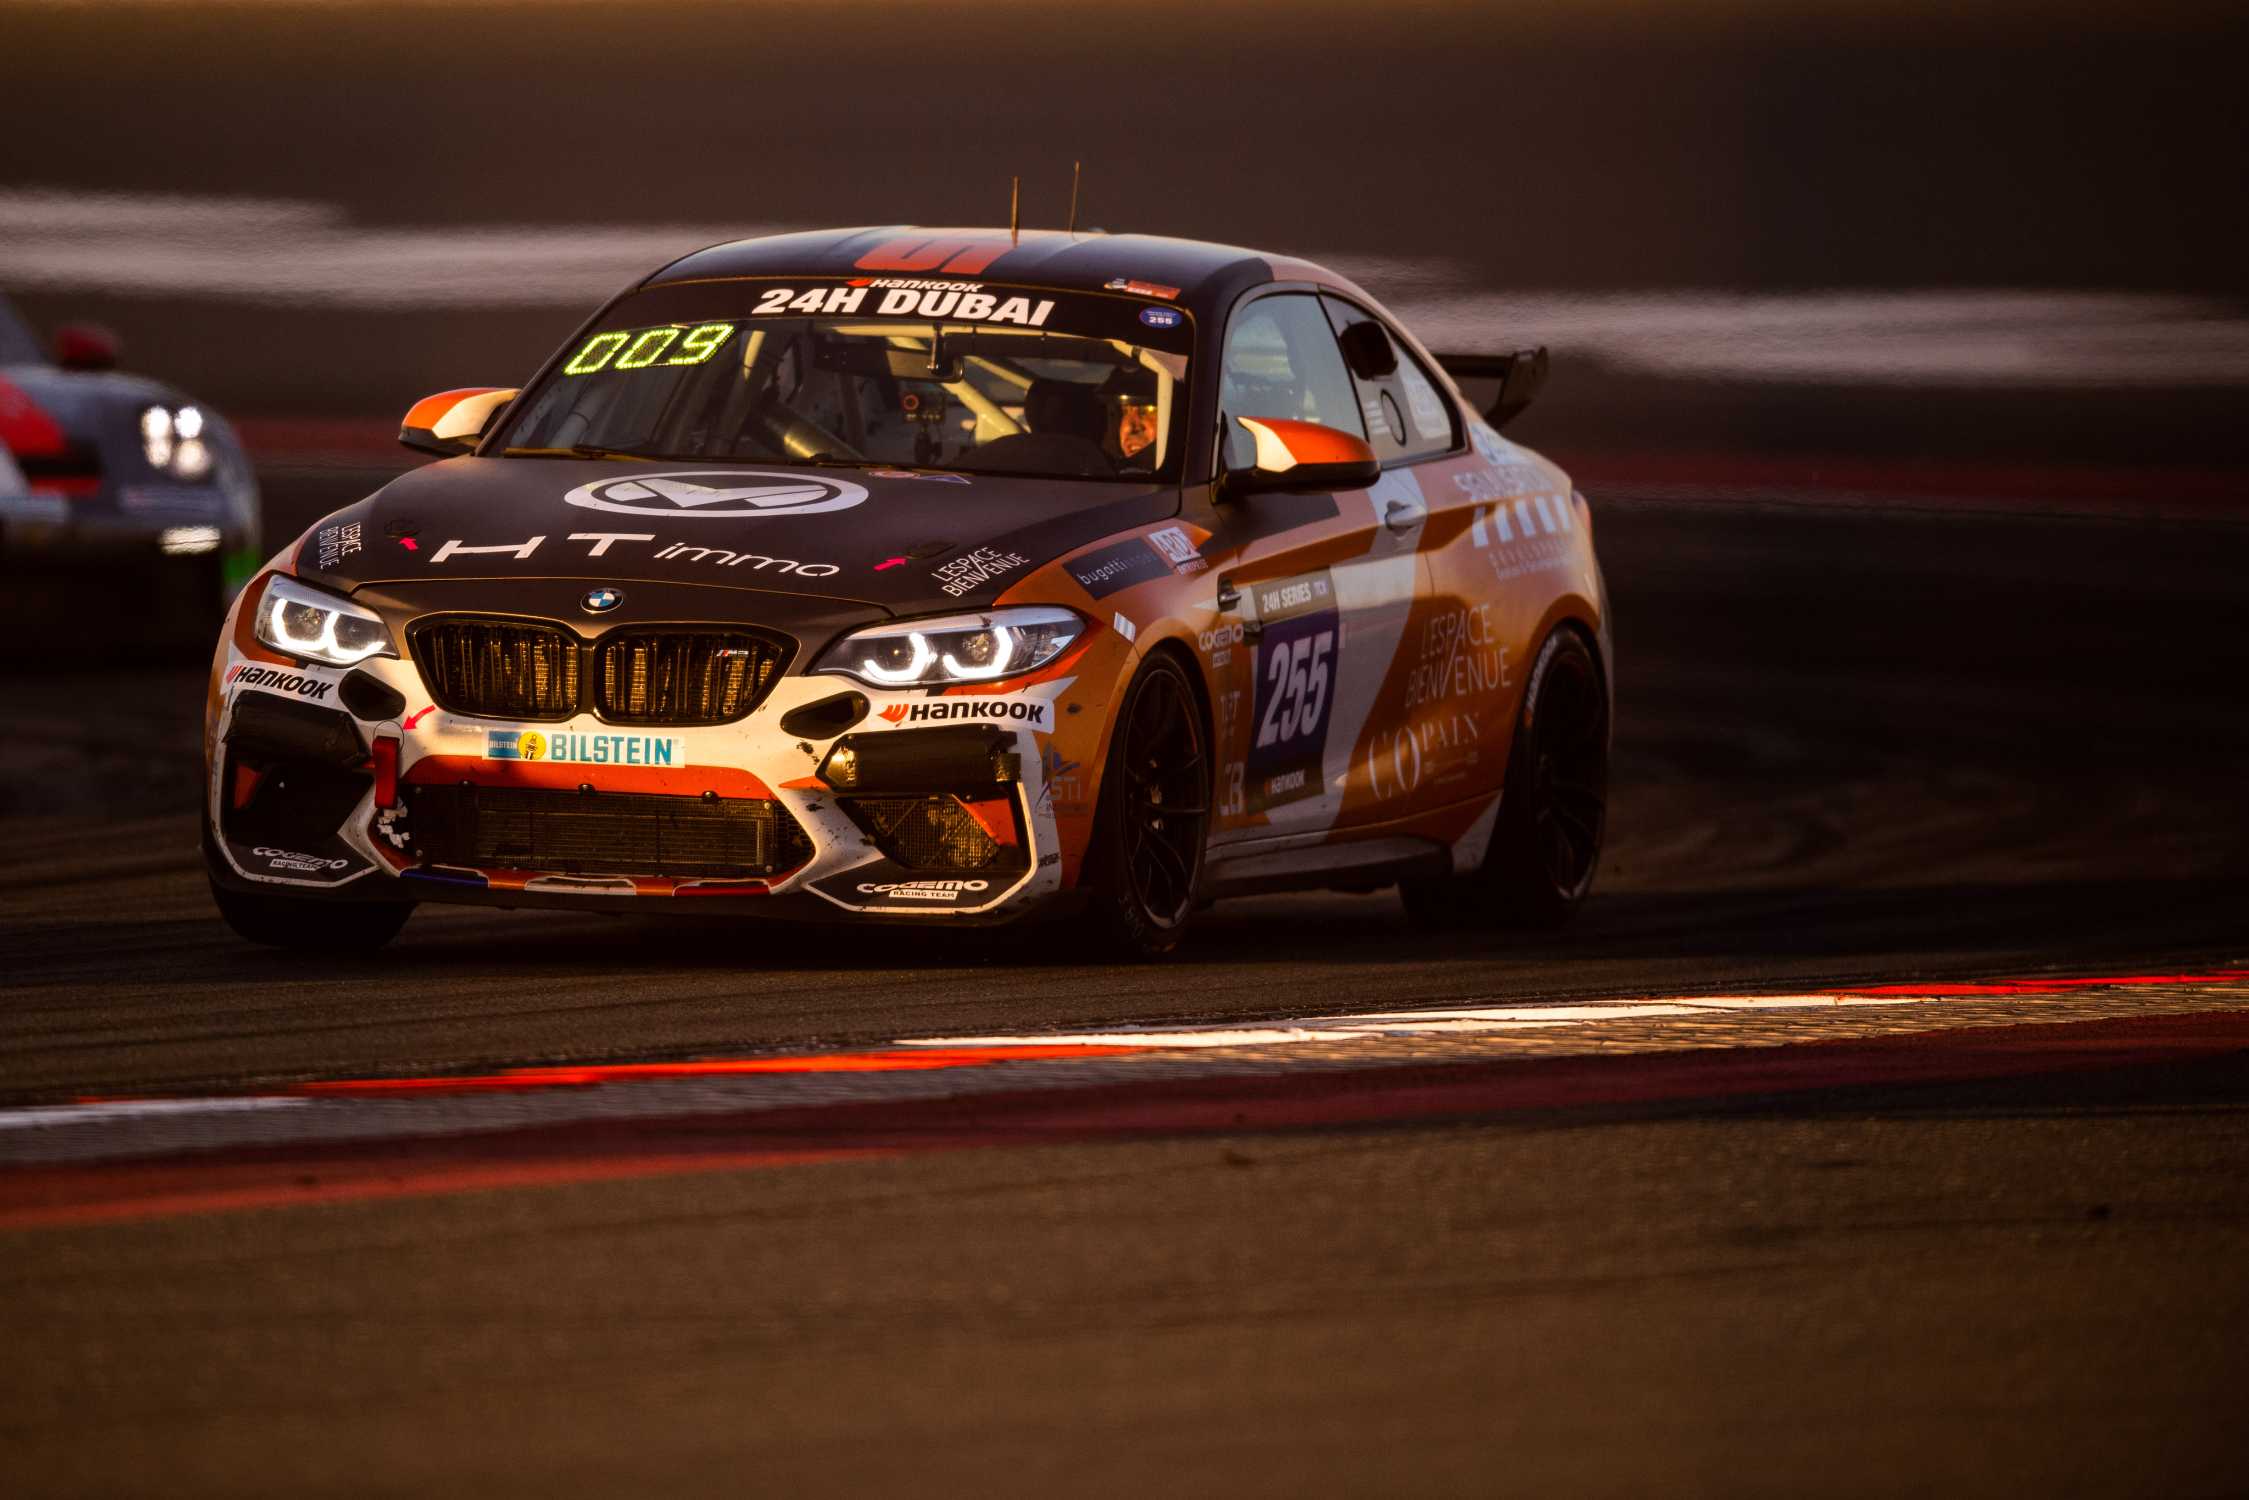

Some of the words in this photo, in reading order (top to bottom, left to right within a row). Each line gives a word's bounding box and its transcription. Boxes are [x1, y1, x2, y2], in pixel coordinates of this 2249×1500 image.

[752, 287, 867, 315] 24H
[876, 291, 1055, 327] DUBAI
[1148, 315, 1173, 325] 255
[563, 323, 735, 375] 009
[653, 541, 840, 577] immo
[941, 552, 1031, 597] BIENVENUE
[1255, 630, 1334, 749] 255
[550, 733, 673, 766] BILSTEIN
[893, 890, 928, 898] RACING
[930, 891, 956, 899] TEAM
